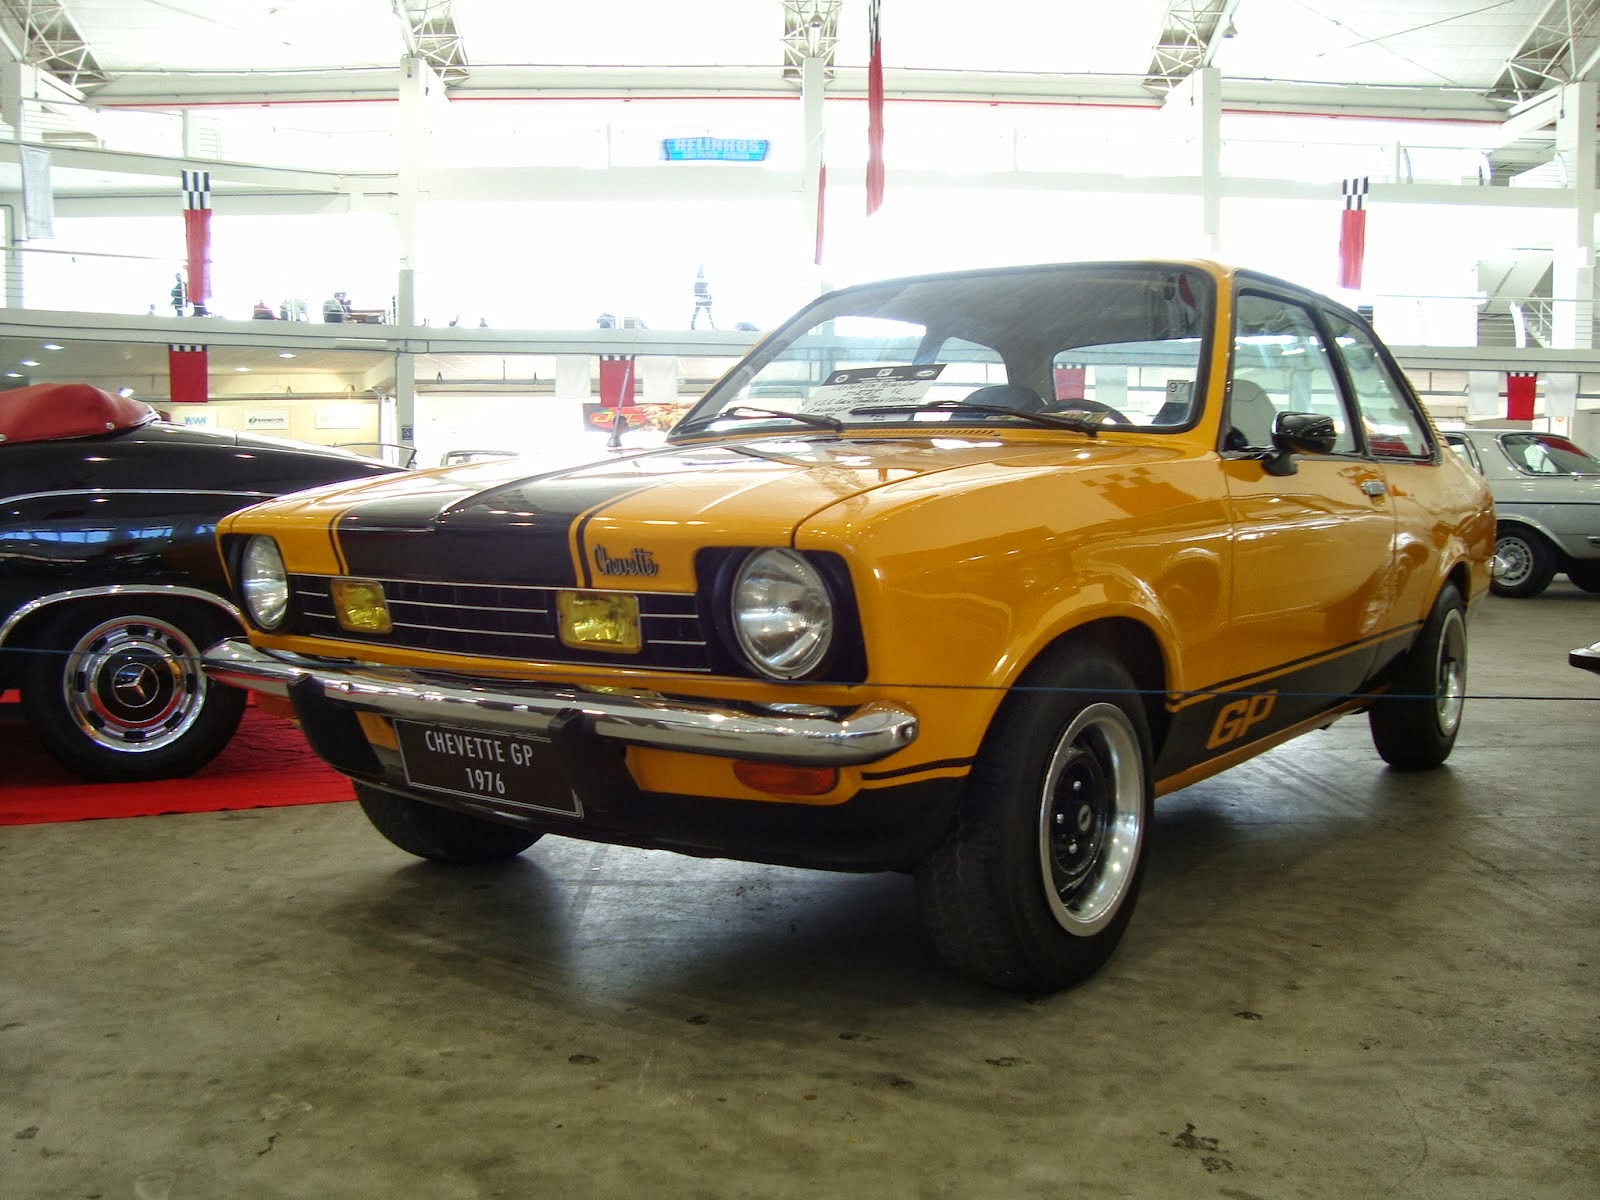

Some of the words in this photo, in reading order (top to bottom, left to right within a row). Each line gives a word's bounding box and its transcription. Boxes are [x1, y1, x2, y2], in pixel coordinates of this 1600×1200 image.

[1169, 382, 1187, 392] 97
[593, 543, 659, 576] Chevette
[1206, 688, 1278, 750] GP
[424, 730, 505, 763] CHEVETTE
[510, 742, 534, 767] GP
[465, 767, 506, 794] 1976
